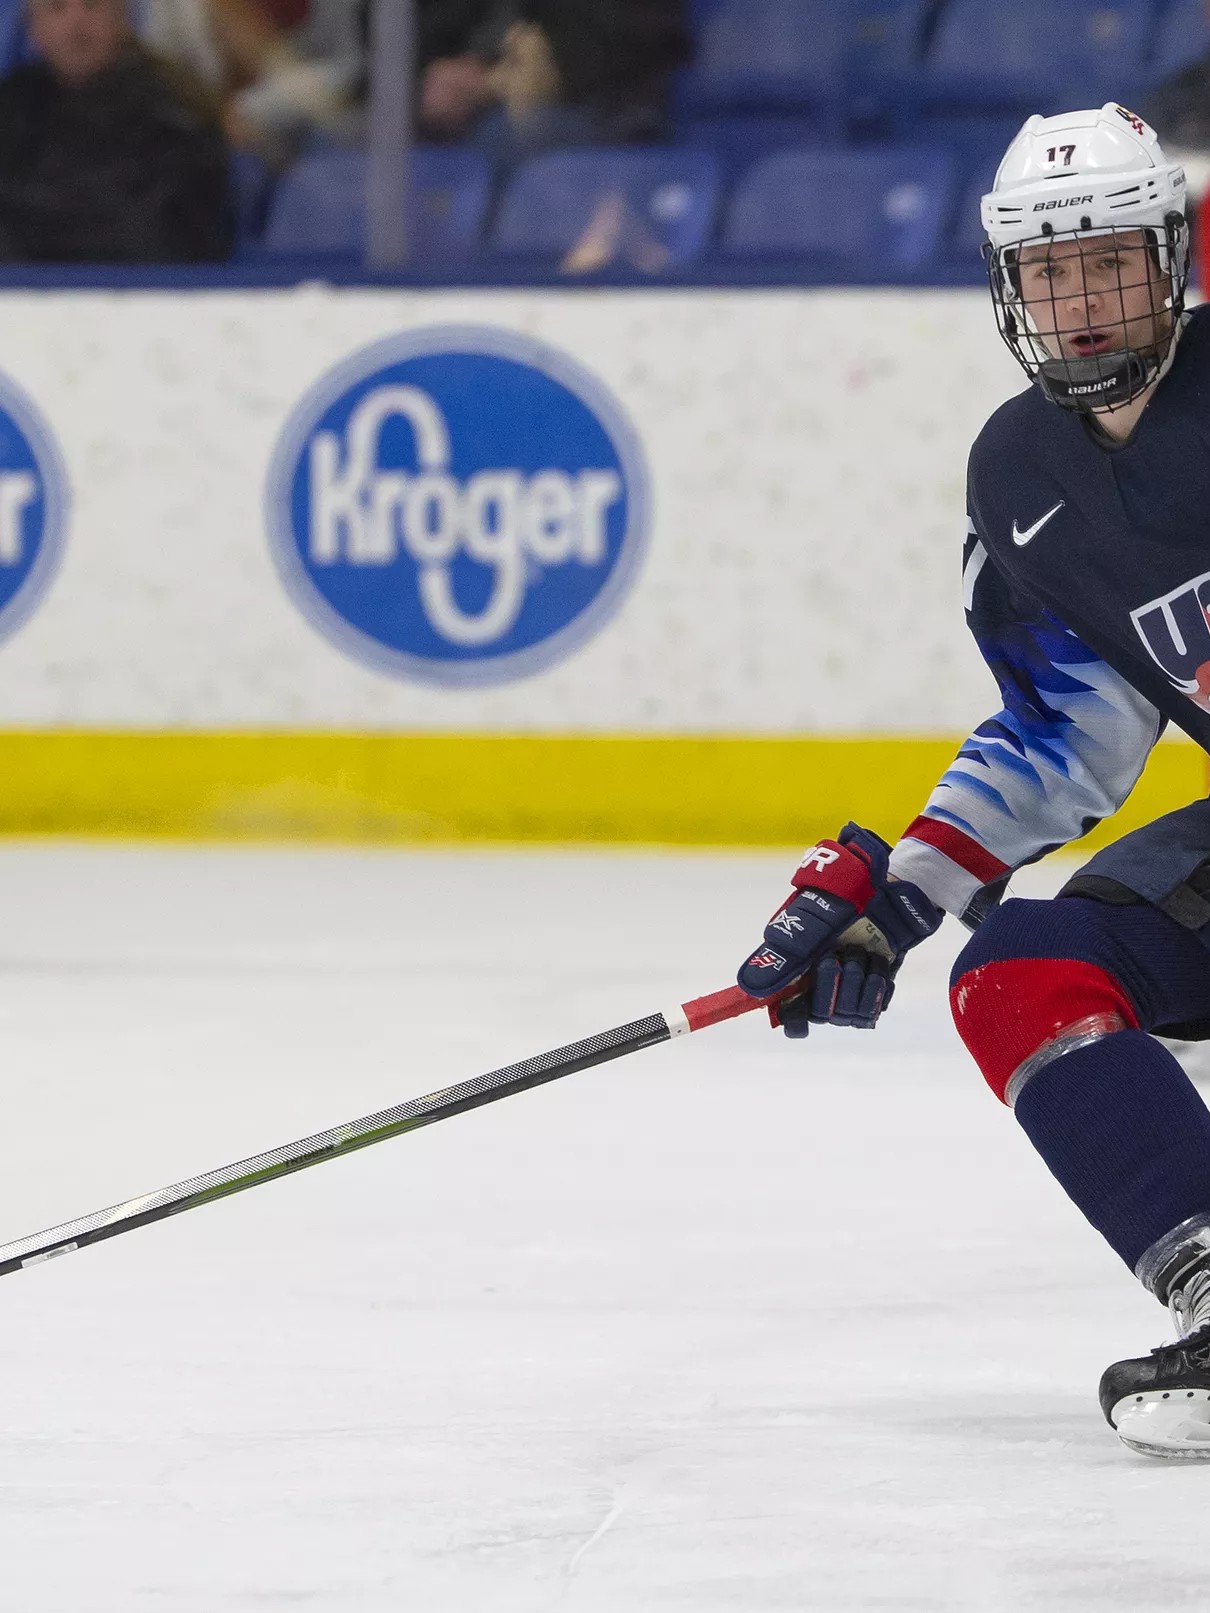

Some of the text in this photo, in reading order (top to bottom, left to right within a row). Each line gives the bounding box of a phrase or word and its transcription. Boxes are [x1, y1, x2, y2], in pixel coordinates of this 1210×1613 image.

[1047, 144, 1077, 166] 17
[1032, 195, 1094, 212] BAUER
[1068, 377, 1117, 395] BAUER
[310, 384, 620, 645] Kroger
